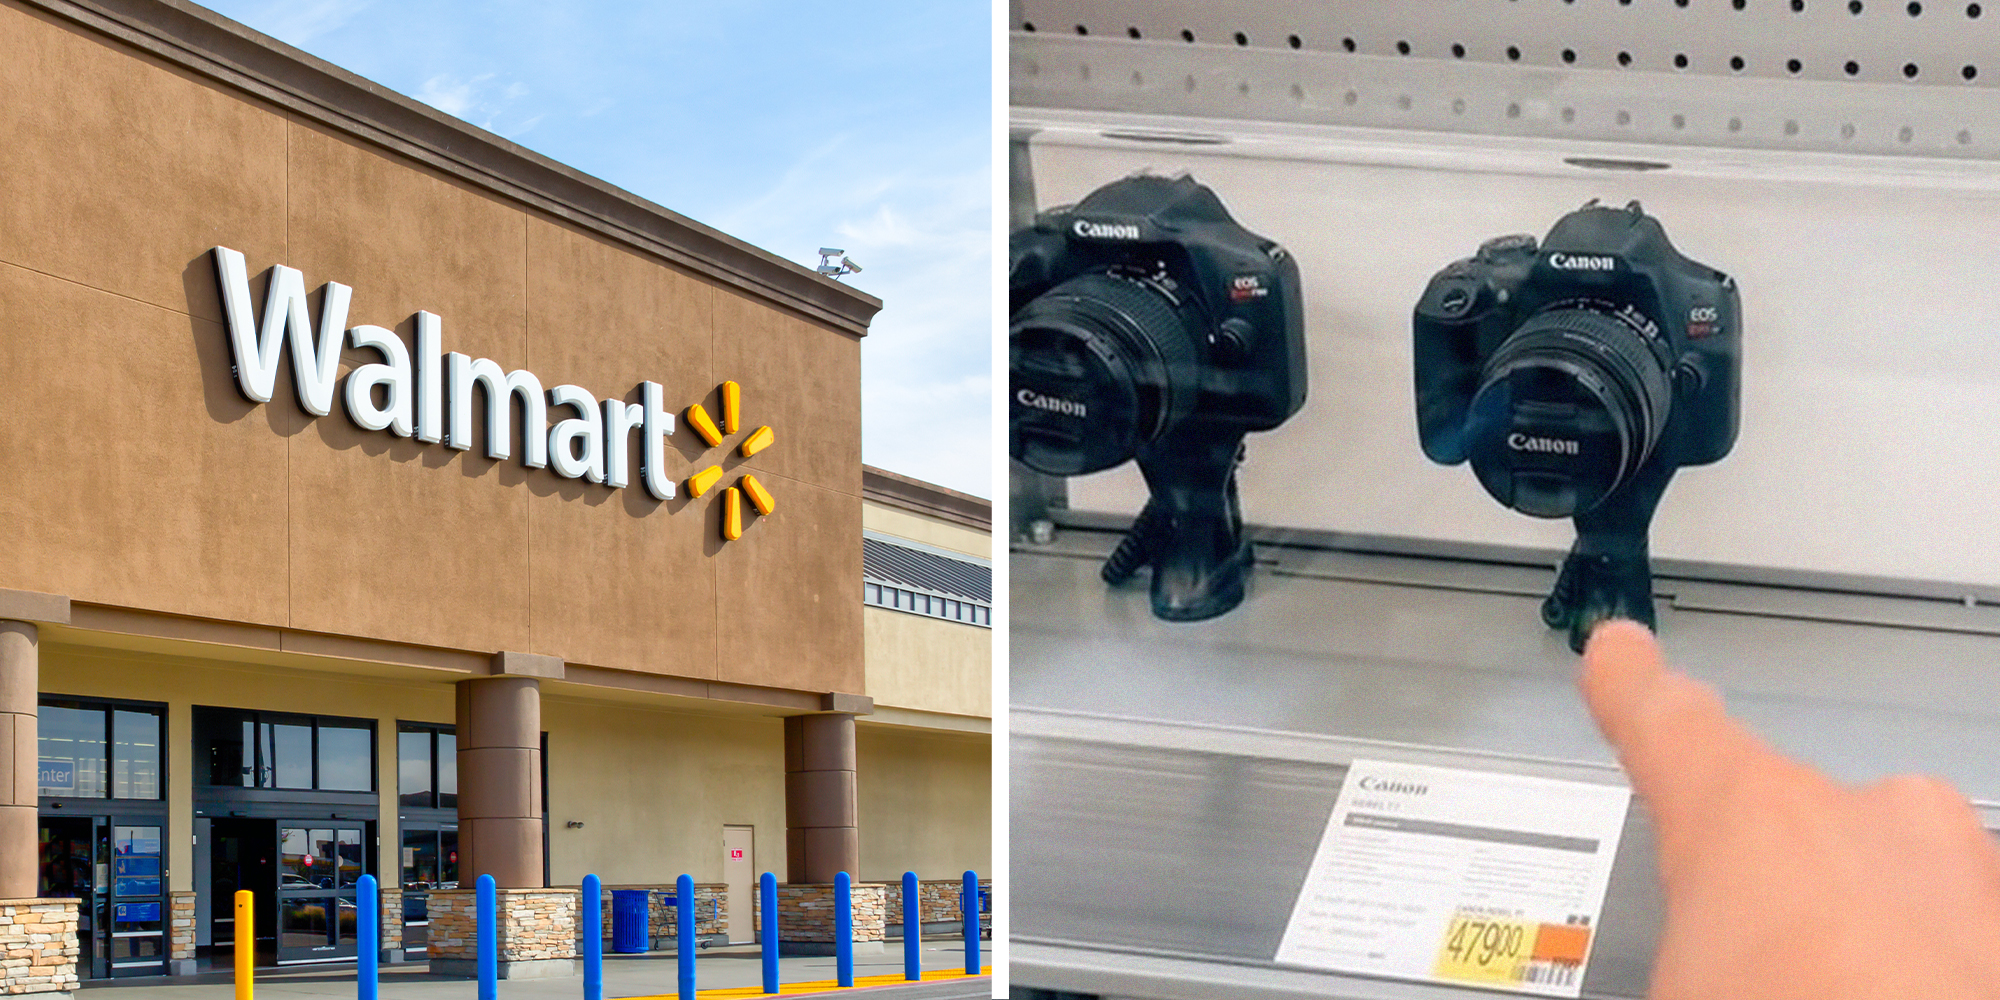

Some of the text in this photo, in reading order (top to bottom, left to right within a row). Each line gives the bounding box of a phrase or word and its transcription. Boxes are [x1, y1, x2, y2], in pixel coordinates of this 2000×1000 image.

[1074, 220, 1140, 240] Canon
[1550, 253, 1615, 271] Canon
[1234, 277, 1259, 290] EOS
[1690, 307, 1718, 321] EOS
[213, 246, 676, 500] Walmart
[1017, 389, 1087, 417] Canon
[1507, 433, 1580, 455] Canon
[1358, 775, 1428, 796] Canon
